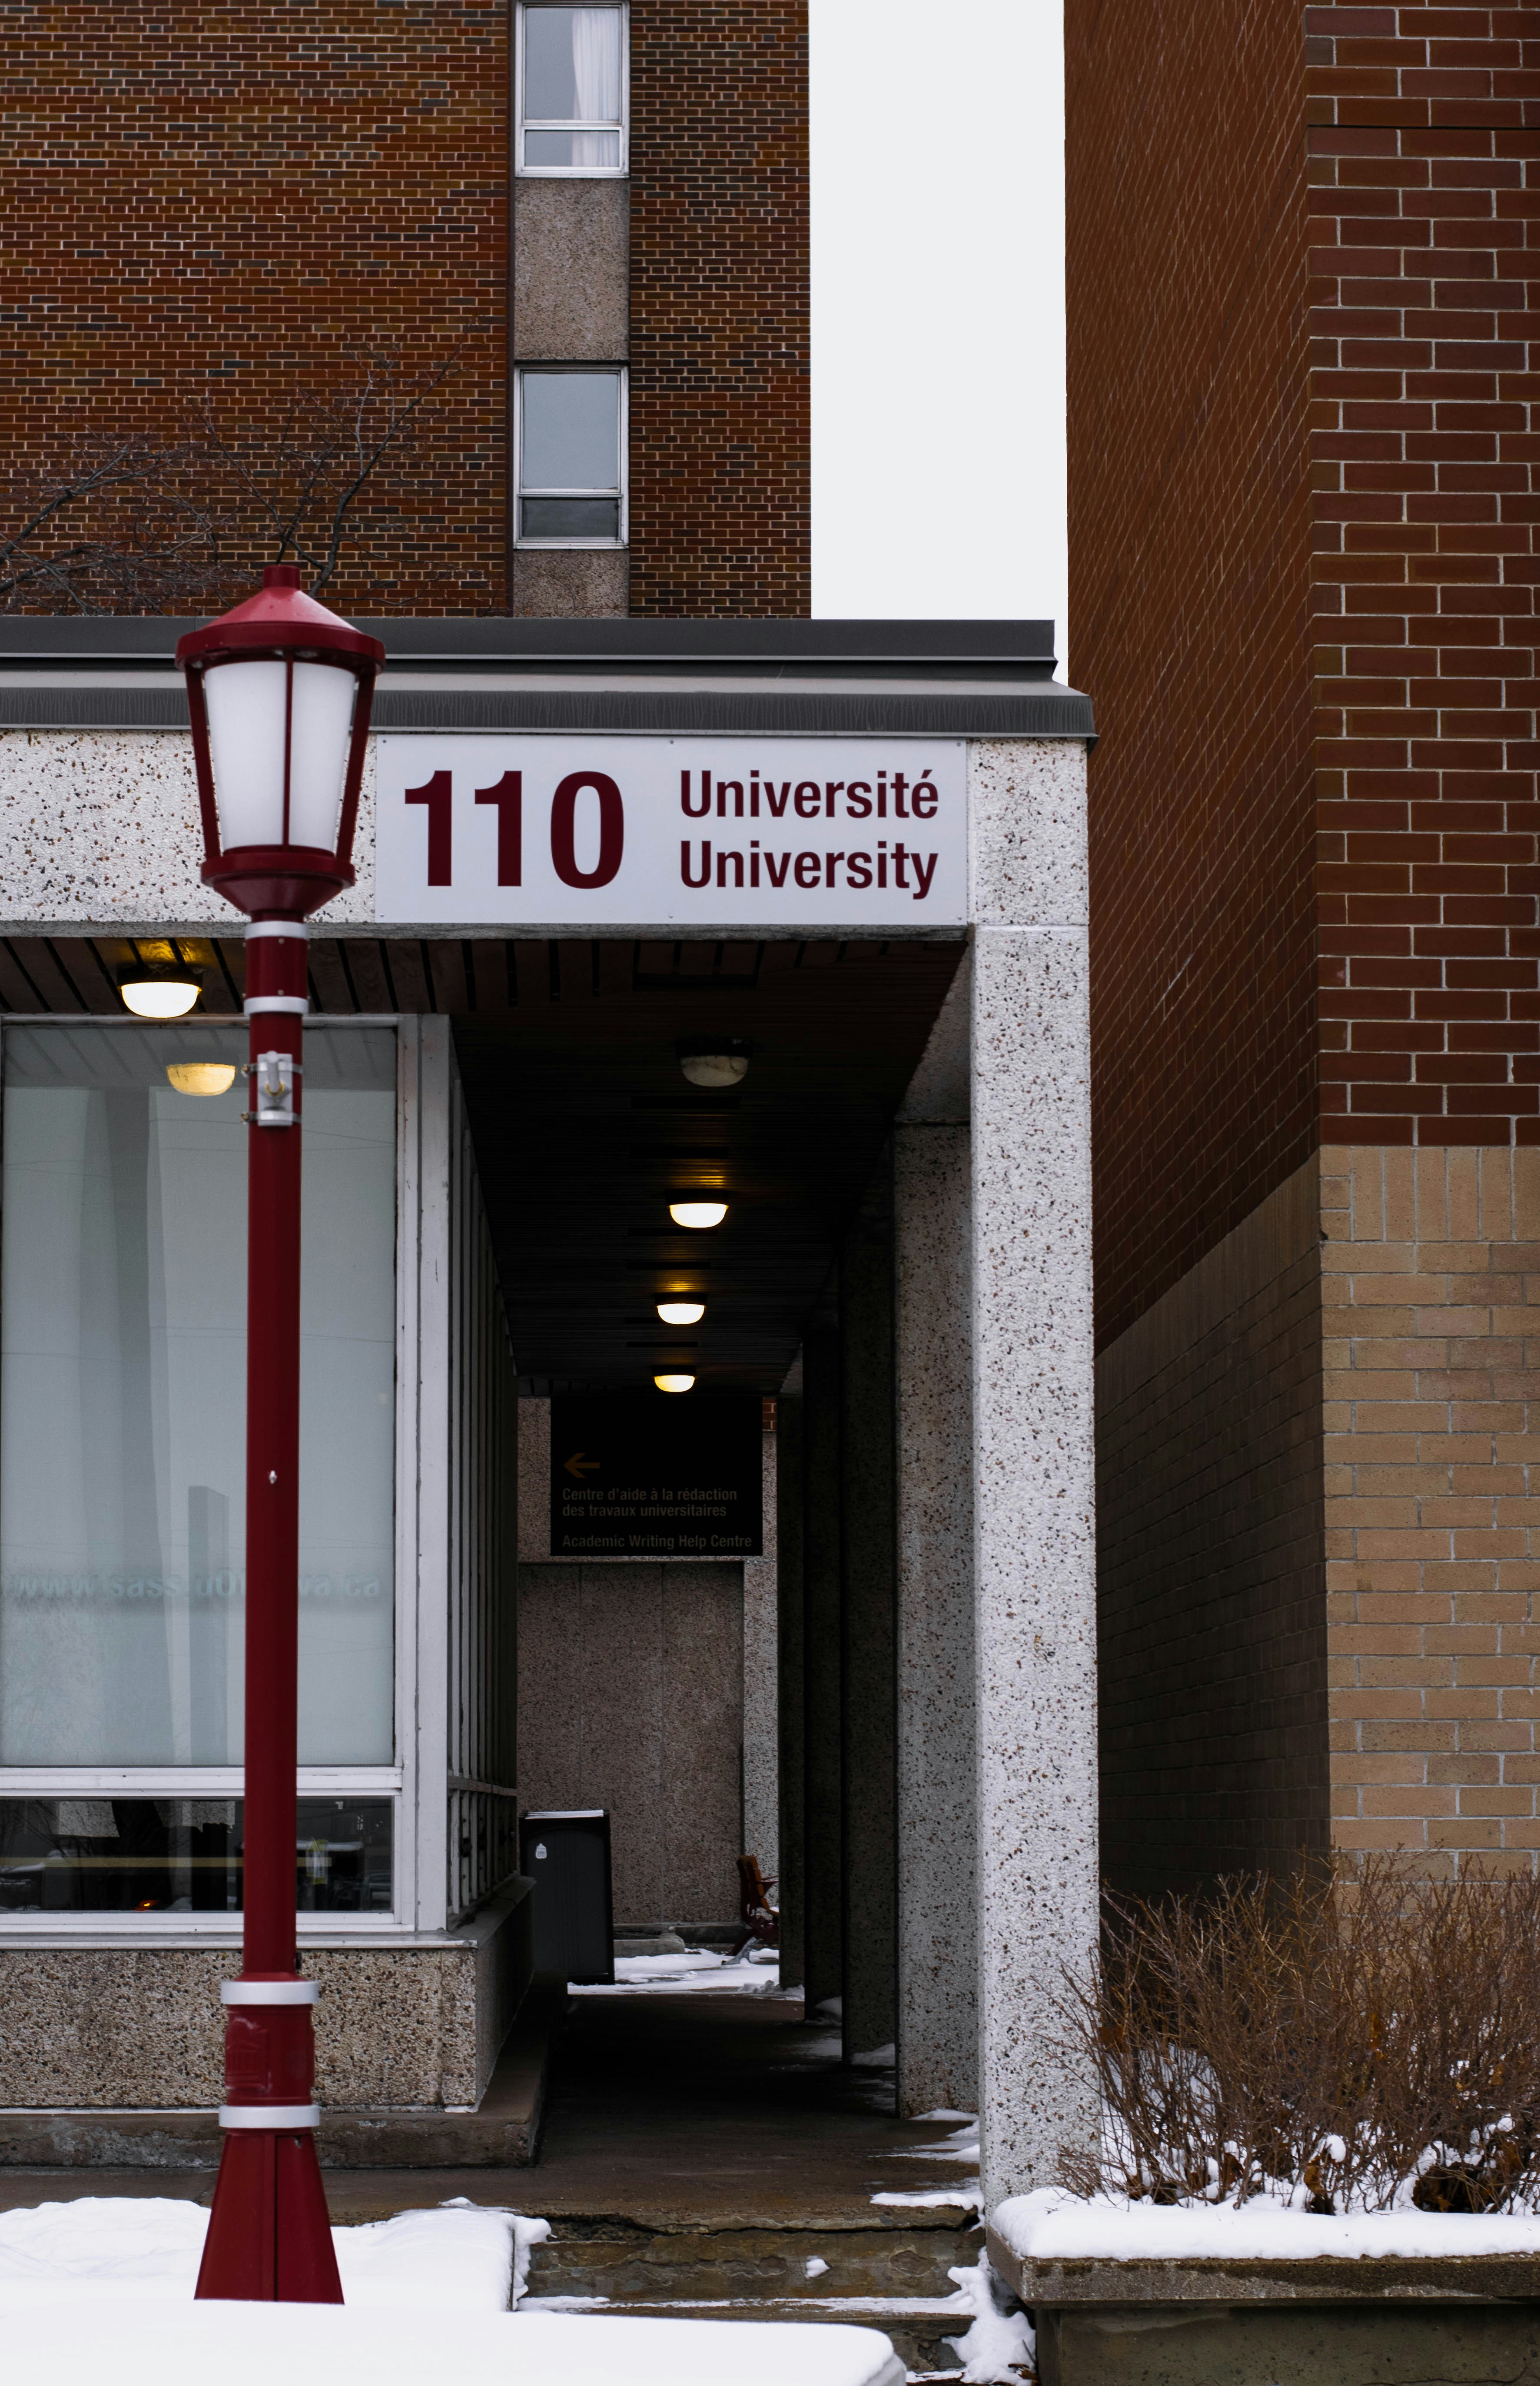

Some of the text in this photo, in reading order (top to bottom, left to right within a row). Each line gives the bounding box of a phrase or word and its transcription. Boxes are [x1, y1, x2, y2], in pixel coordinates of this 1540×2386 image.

[681, 769, 939, 819] Université
[405, 770, 624, 889] 110
[681, 840, 939, 900] University
[563, 1488, 737, 1501] Centre d'aide à la rédaction
[563, 1504, 727, 1516] des travaux universitaires
[562, 1535, 752, 1550] Academic Writing Help Centre
